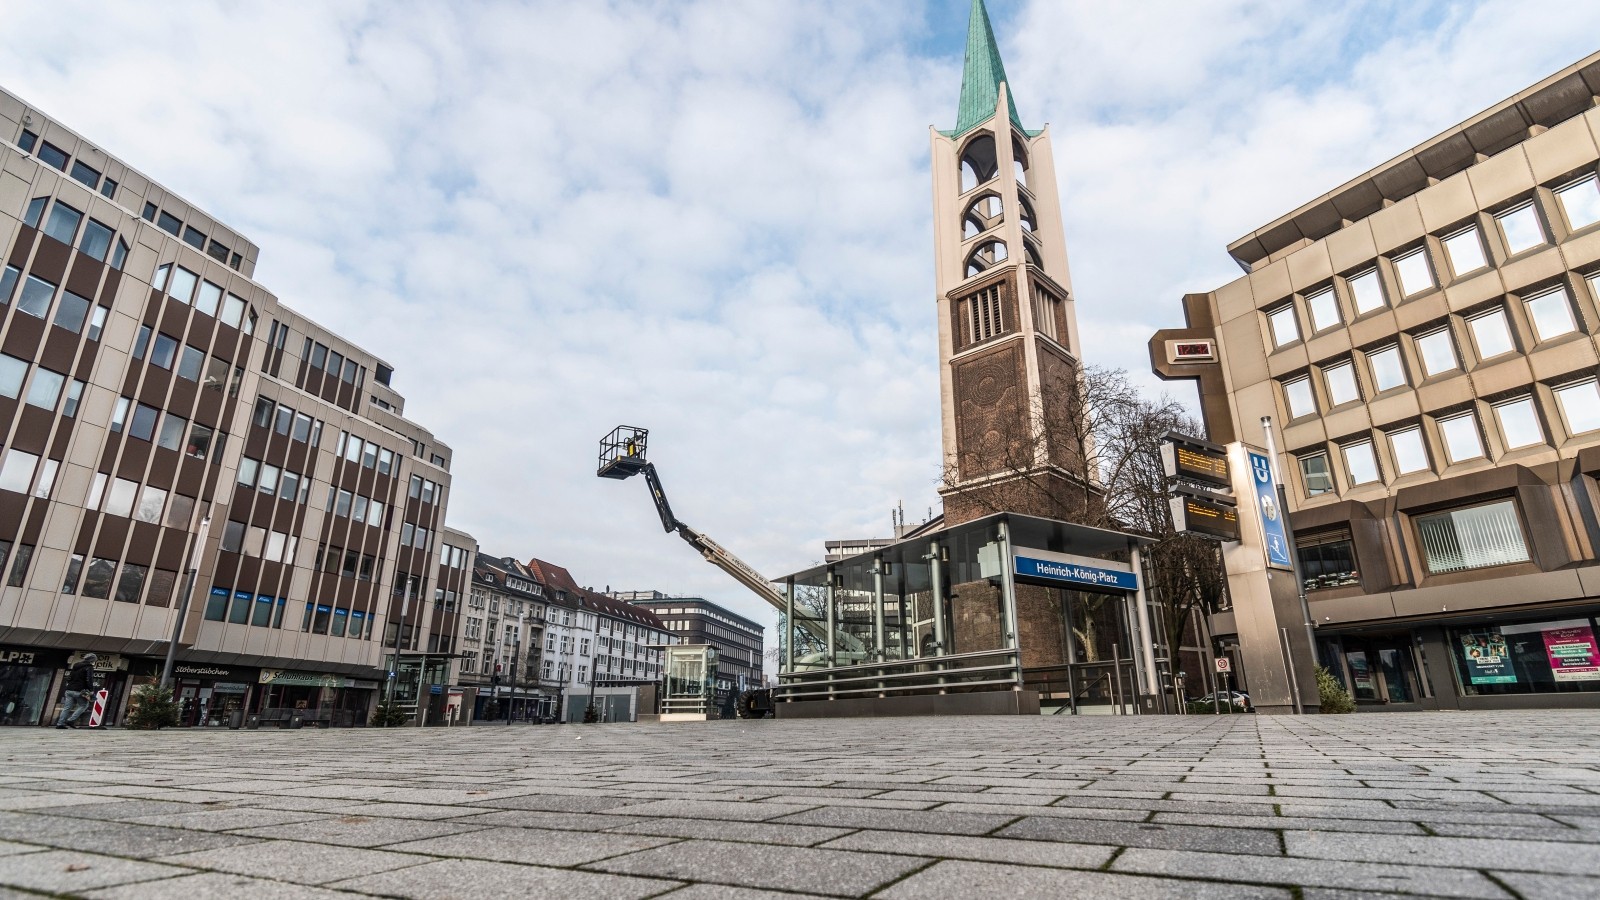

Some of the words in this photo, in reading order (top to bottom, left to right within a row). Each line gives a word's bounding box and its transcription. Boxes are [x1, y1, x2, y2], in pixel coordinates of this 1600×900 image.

[1036, 562, 1119, 584] Heinrich-König-Platz
[175, 665, 229, 676] Stöberstübchen
[273, 671, 314, 681] Schuhhaus
